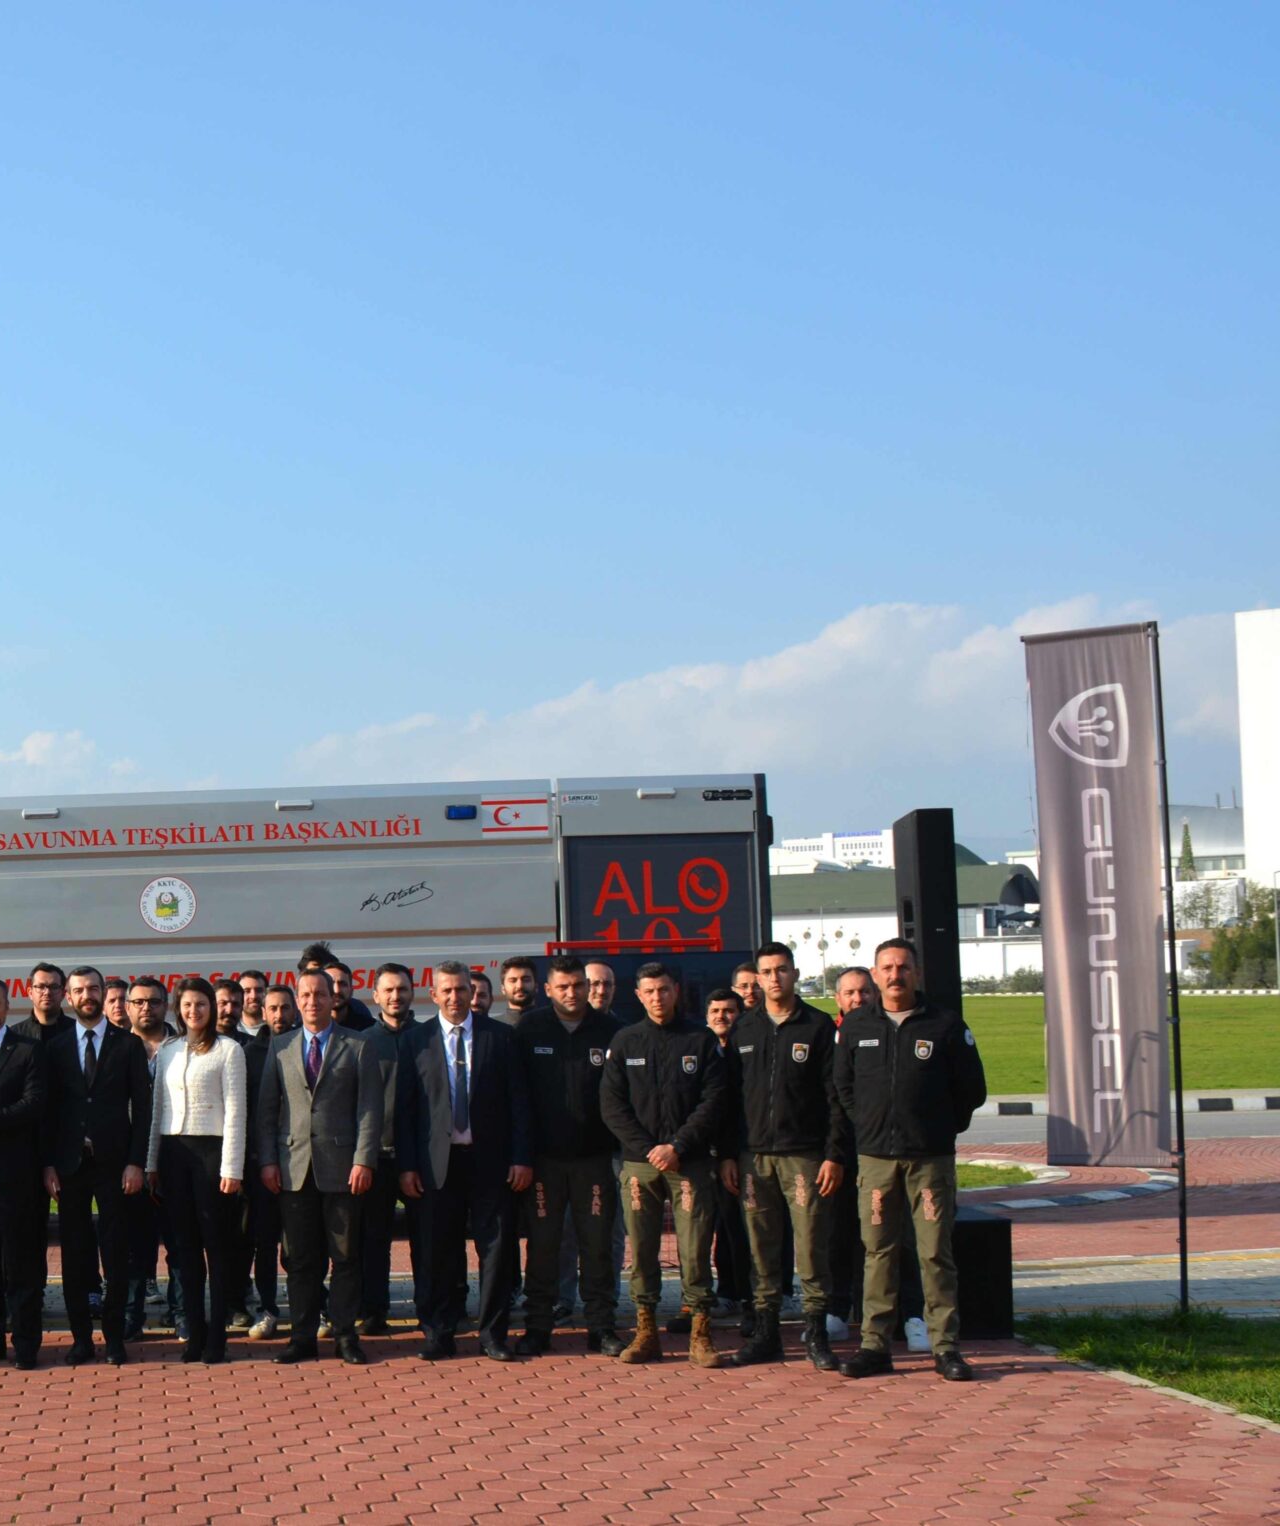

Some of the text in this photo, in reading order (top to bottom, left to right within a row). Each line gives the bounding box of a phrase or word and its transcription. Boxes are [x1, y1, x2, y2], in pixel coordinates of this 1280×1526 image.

[123, 822, 254, 849] TEŞKİLATI
[264, 815, 422, 844] BAŞKANLIĞI
[593, 857, 729, 916] ALO
